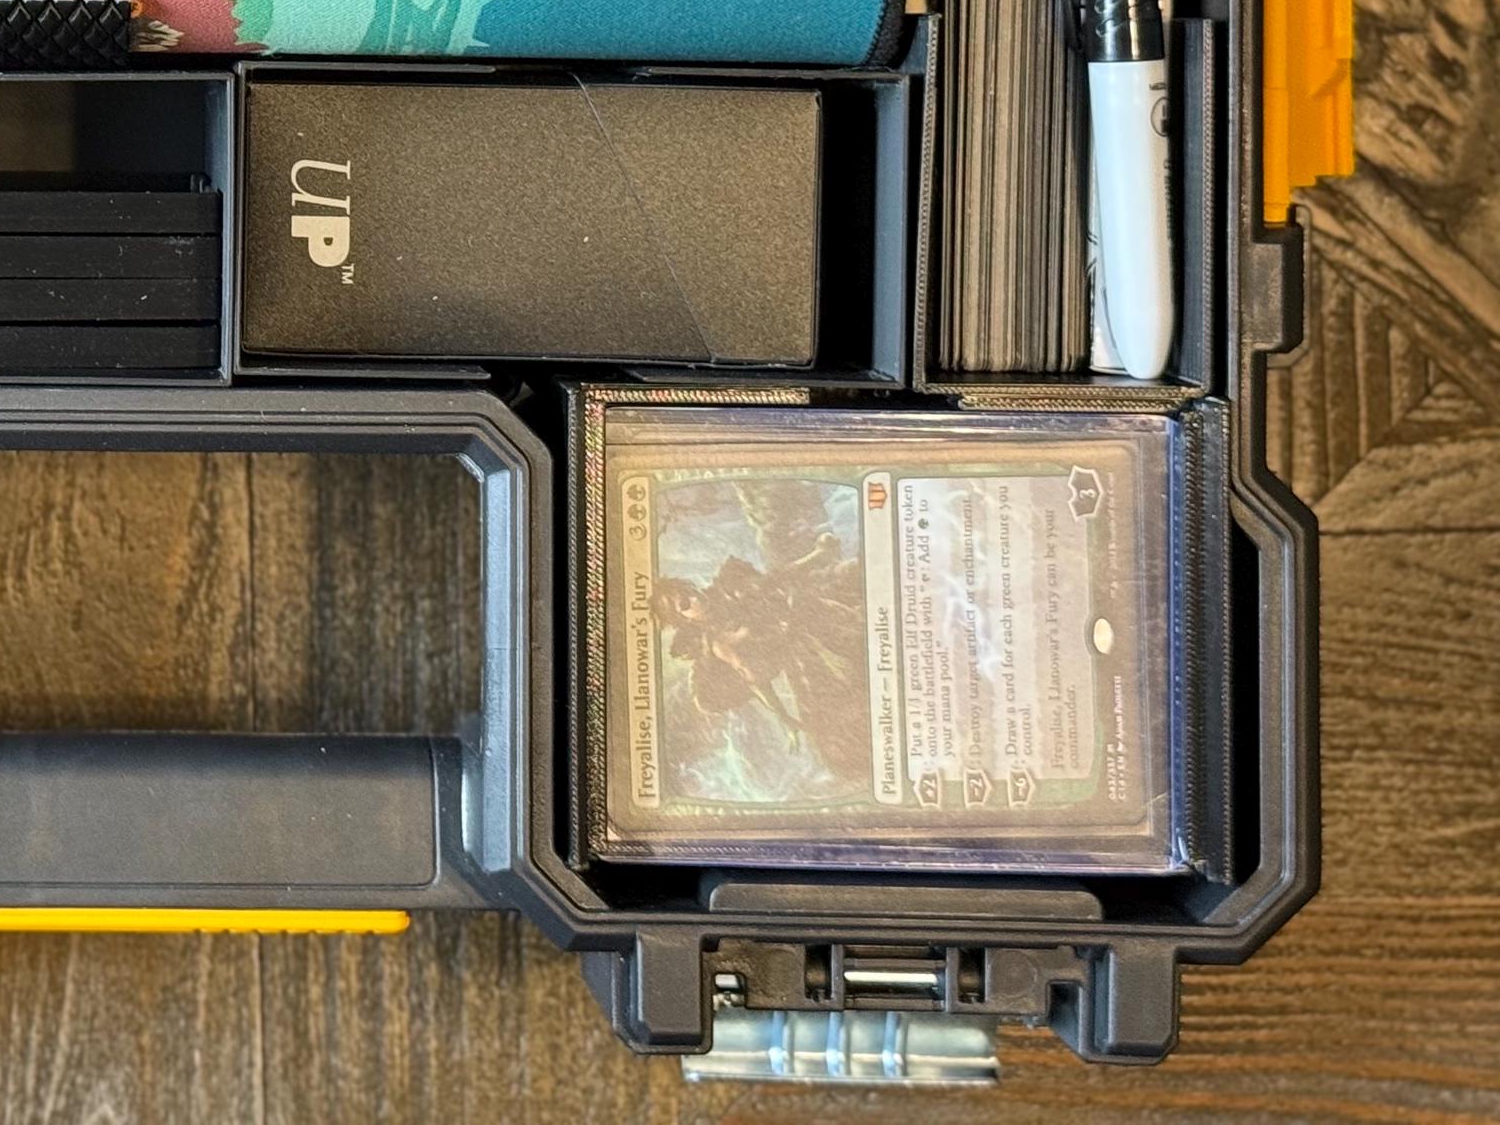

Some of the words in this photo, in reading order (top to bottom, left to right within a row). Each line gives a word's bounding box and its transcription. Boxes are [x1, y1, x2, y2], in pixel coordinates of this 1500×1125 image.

[901, 486, 914, 522] token
[904, 527, 916, 581] creature
[631, 572, 654, 607] Fury
[905, 586, 917, 625] Druid
[874, 607, 895, 671] Freyalise
[906, 631, 918, 649] Elf
[632, 611, 652, 710] Llanowar's
[910, 655, 922, 691] green
[634, 717, 659, 798] Freyalise,
[876, 696, 895, 795] Planeswalker
[909, 734, 921, 757] Put
